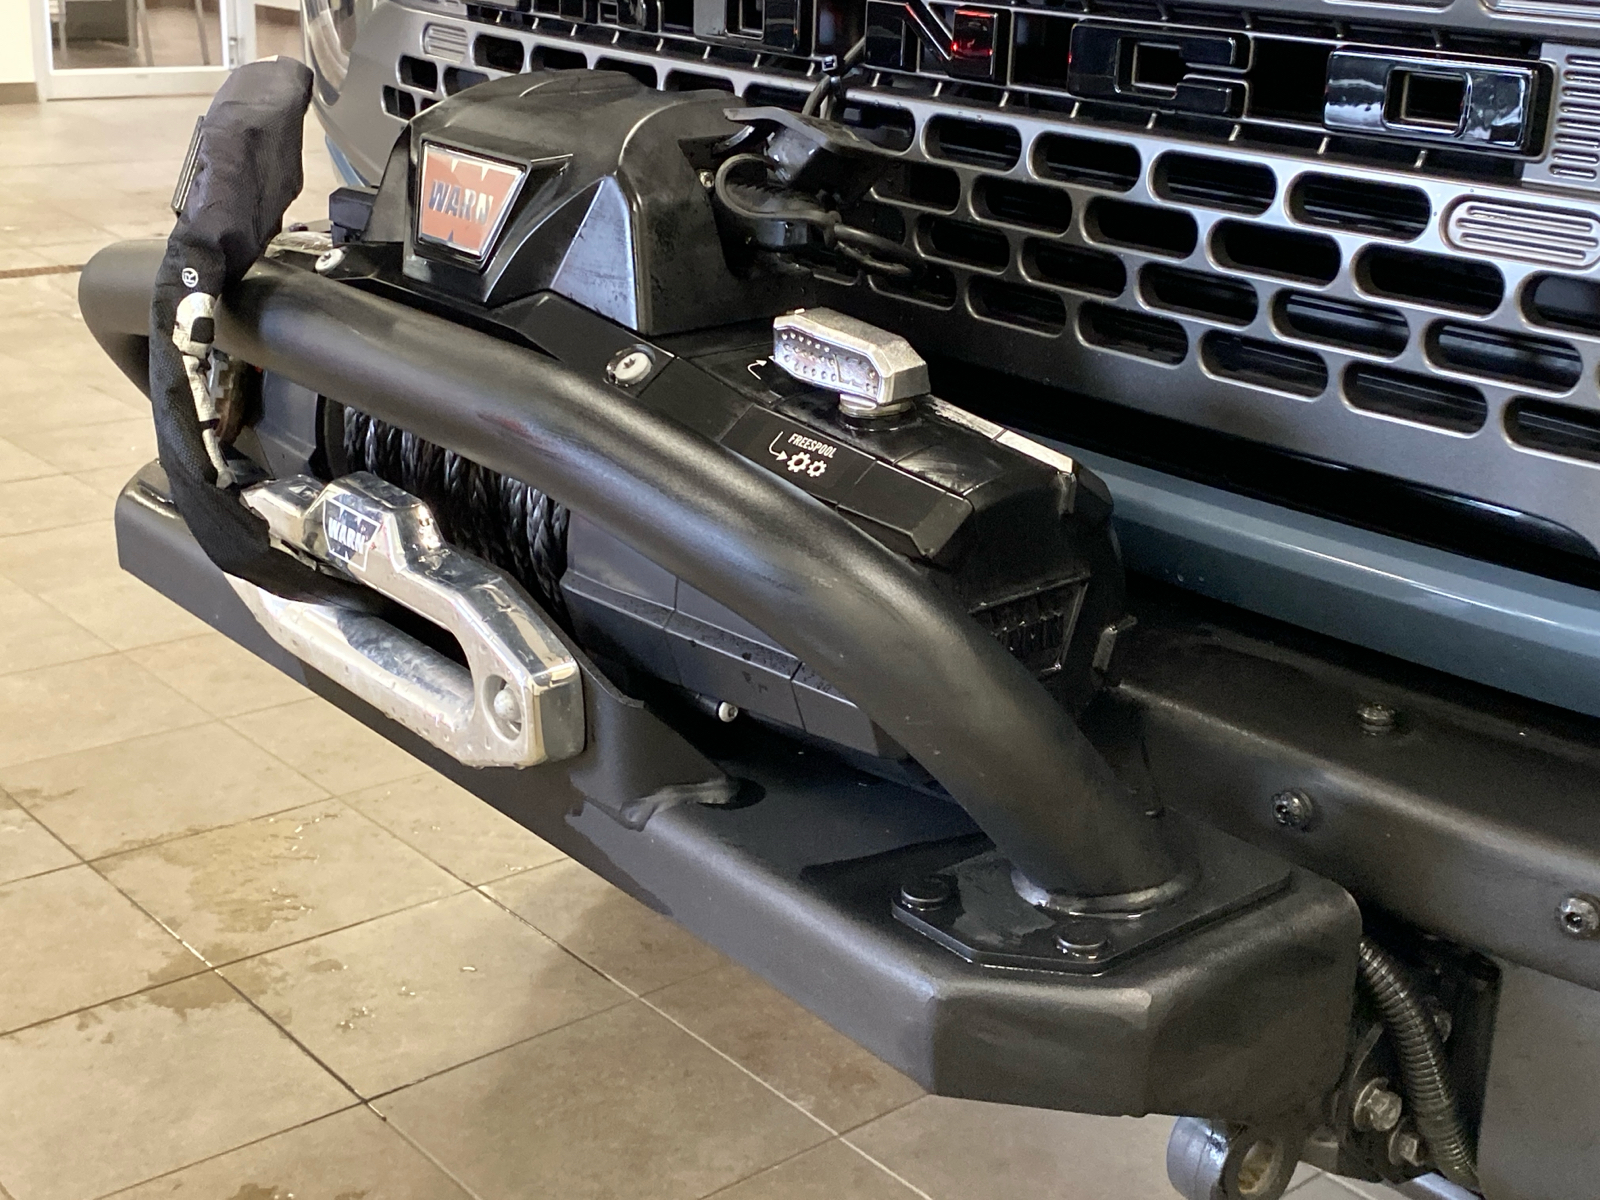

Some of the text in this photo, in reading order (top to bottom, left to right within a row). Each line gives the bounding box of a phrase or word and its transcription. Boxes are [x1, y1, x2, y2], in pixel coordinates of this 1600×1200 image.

[458, 0, 1540, 152] ONCO
[428, 180, 494, 225] WARN
[788, 432, 837, 459] FREESPOOL
[328, 516, 366, 555] WARN
